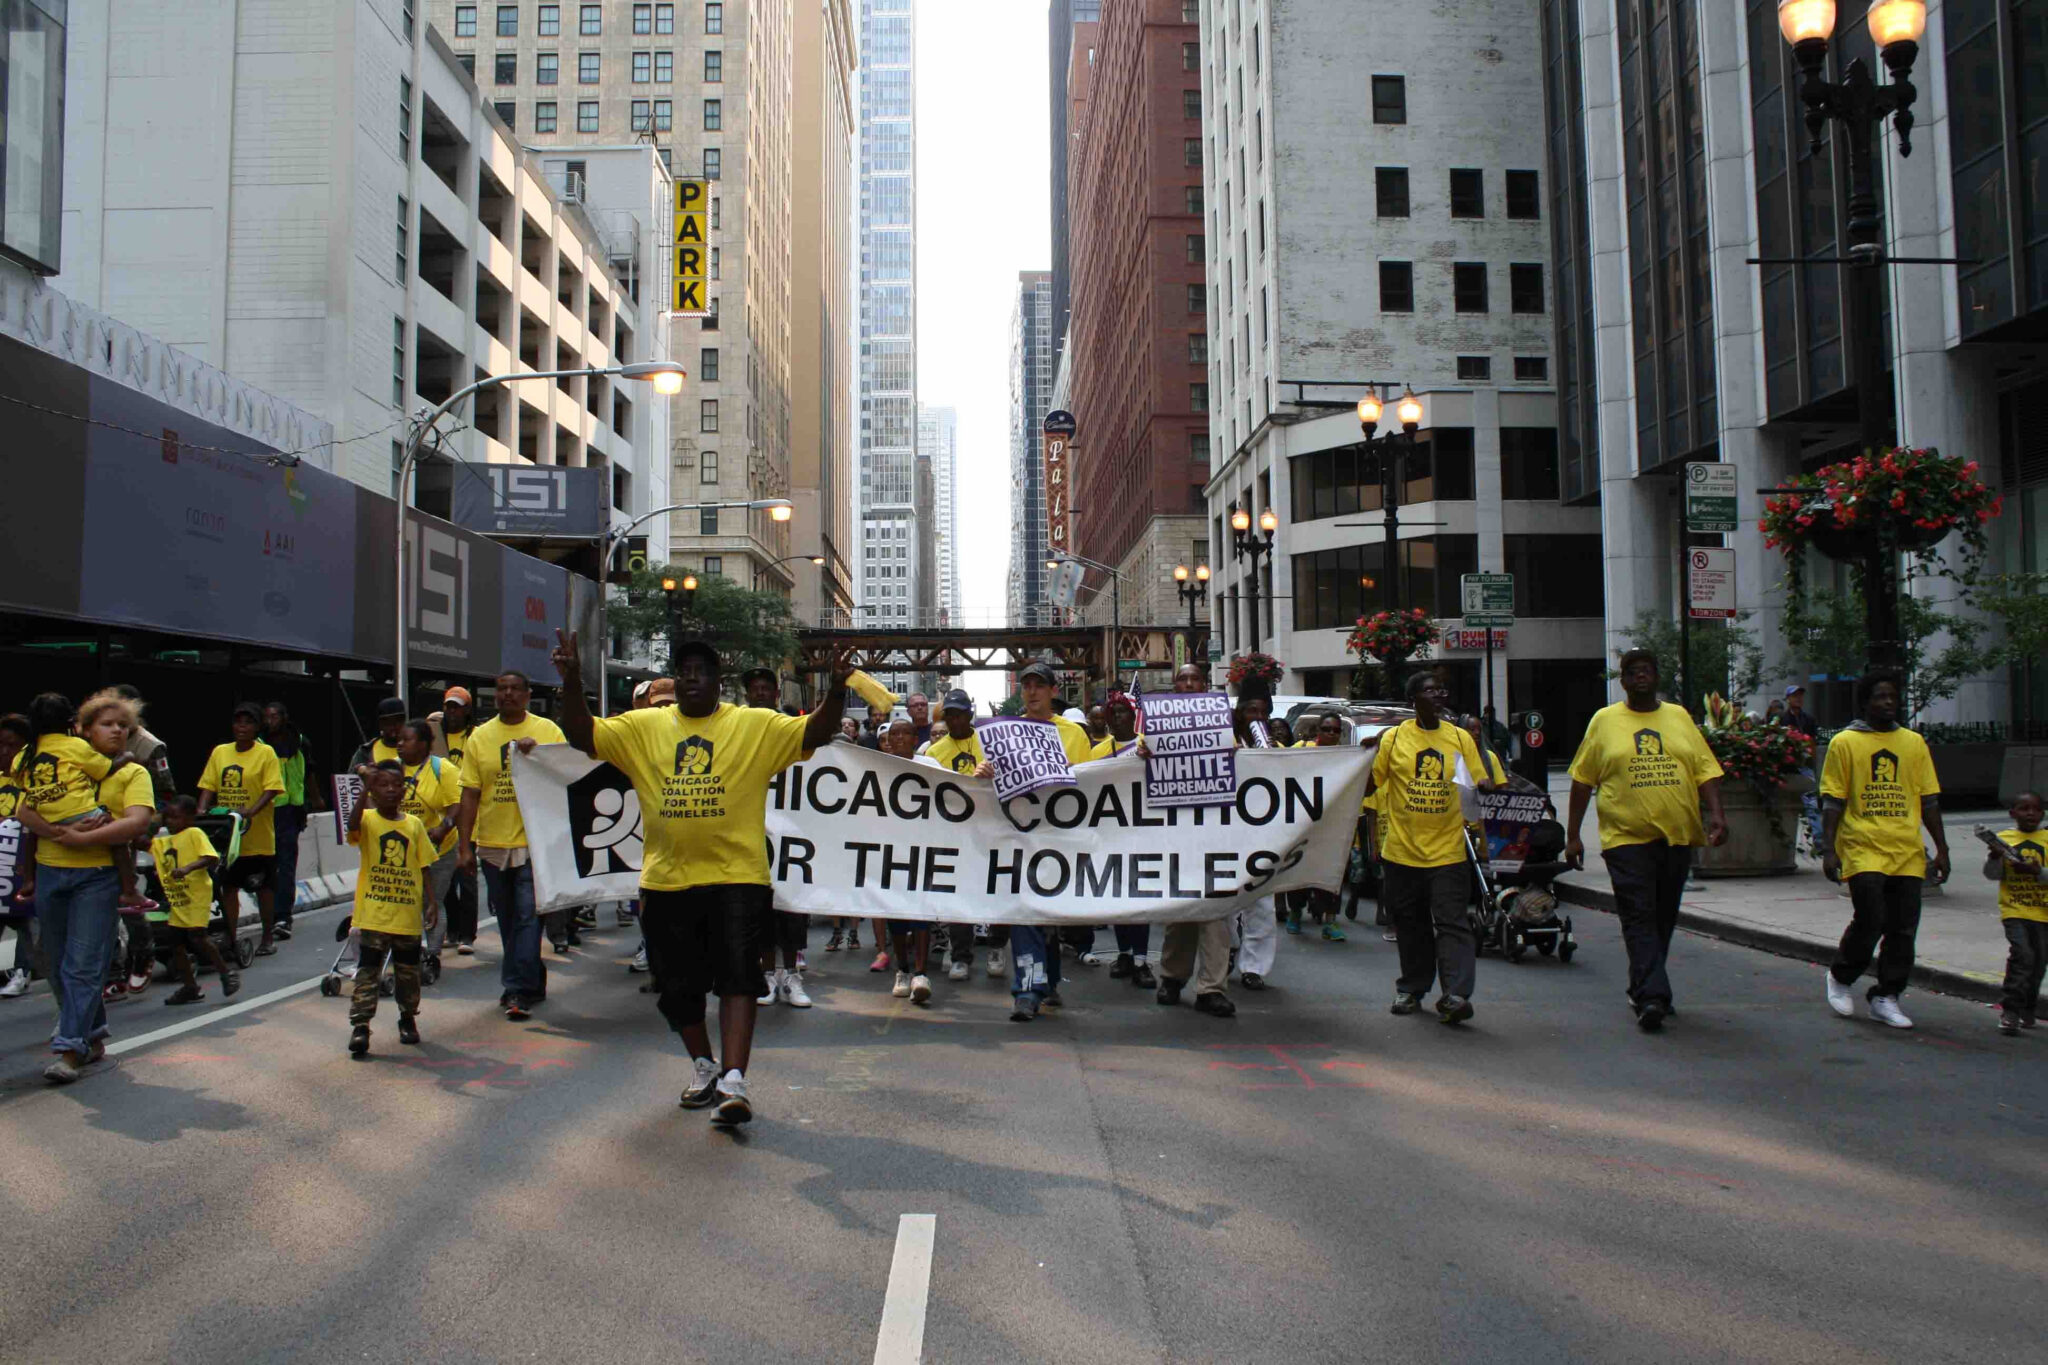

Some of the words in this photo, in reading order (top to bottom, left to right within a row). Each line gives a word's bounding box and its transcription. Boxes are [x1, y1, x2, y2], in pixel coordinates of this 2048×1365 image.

[678, 183, 702, 309] PARK
[488, 468, 566, 509] 151
[1049, 440, 1064, 541] Pala
[406, 518, 470, 640] 151
[1143, 696, 1228, 717] WORKERS
[1146, 715, 1193, 732] STRIKE
[1195, 713, 1231, 727] BACK
[979, 723, 1046, 746] UNIONS
[1156, 731, 1222, 752] AGAINST
[984, 736, 1062, 761] SOLUTION
[997, 748, 1067, 775] RIGGED
[1150, 752, 1231, 781] WHITE
[1628, 763, 1678, 772] COALITION
[1630, 756, 1672, 764] CHICAGO
[665, 775, 721, 786] CHICAGO
[994, 763, 1070, 794] ECONOMY
[1150, 777, 1233, 796] SUPREMACY
[1630, 779, 1681, 789] HOMELESS
[661, 786, 725, 796] COALITION
[768, 765, 975, 823] HICAGO
[1001, 776, 1324, 833] COALON
[1406, 787, 1450, 797] COALITION
[1408, 796, 1427, 805] FOR
[1429, 797, 1447, 805] THE
[664, 798, 687, 807] FOR
[692, 797, 718, 807] THE
[1507, 795, 1547, 810] NEEDS
[659, 808, 726, 819] HOMELESS
[1496, 808, 1541, 823] UNIONS
[844, 841, 960, 893] THE
[986, 838, 1309, 899] HOMELESS
[371, 884, 391, 894] FOR
